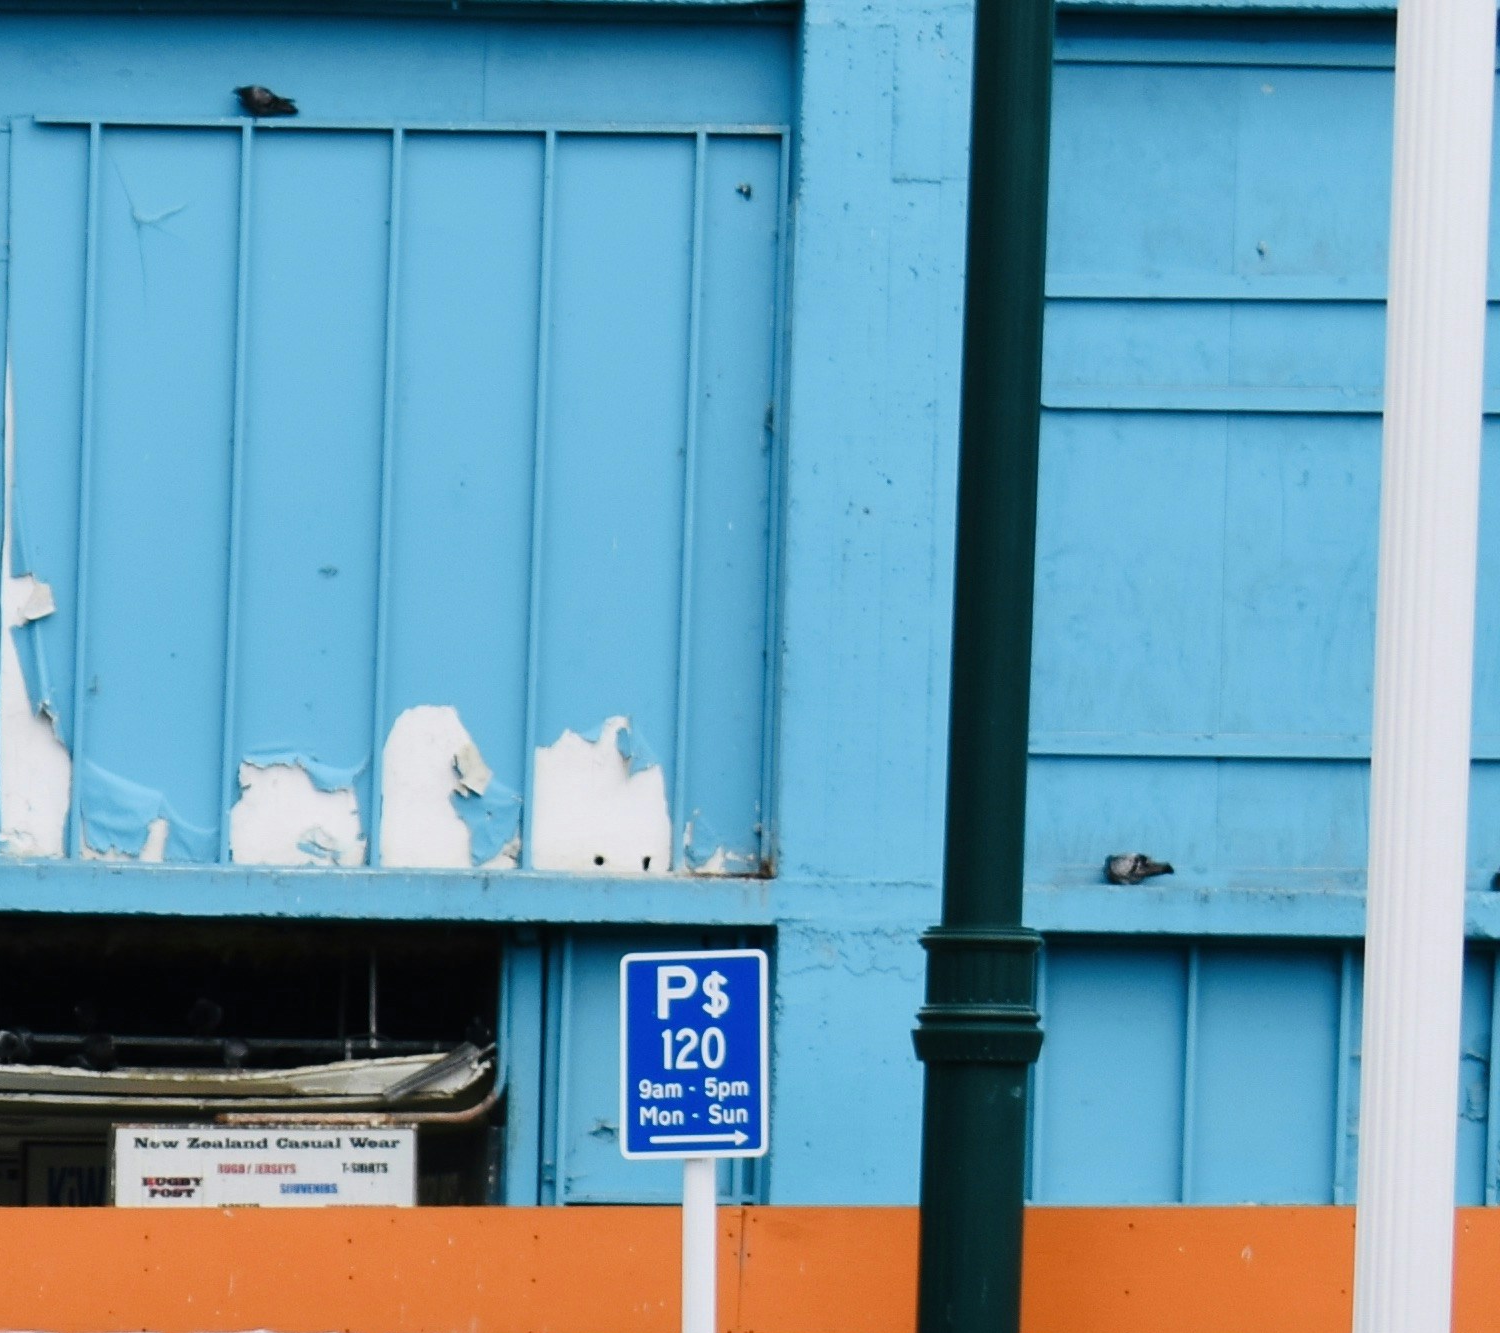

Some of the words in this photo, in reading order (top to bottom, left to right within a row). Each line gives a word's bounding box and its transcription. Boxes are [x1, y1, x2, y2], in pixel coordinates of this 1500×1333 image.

[657, 965, 730, 1019] P$
[661, 1027, 726, 1069] 120
[638, 1079, 682, 1099] 9am
[704, 1077, 749, 1101] 5pm
[639, 1106, 684, 1126] Mon
[707, 1104, 748, 1124] Sun
[134, 1137, 179, 1149] New
[187, 1137, 268, 1149] Zealand
[276, 1137, 341, 1149] Casual
[349, 1137, 400, 1149] Wear
[342, 1162, 388, 1173] T-SHIRTS
[143, 1177, 203, 1187] RUGBY
[149, 1188, 196, 1198] POST
